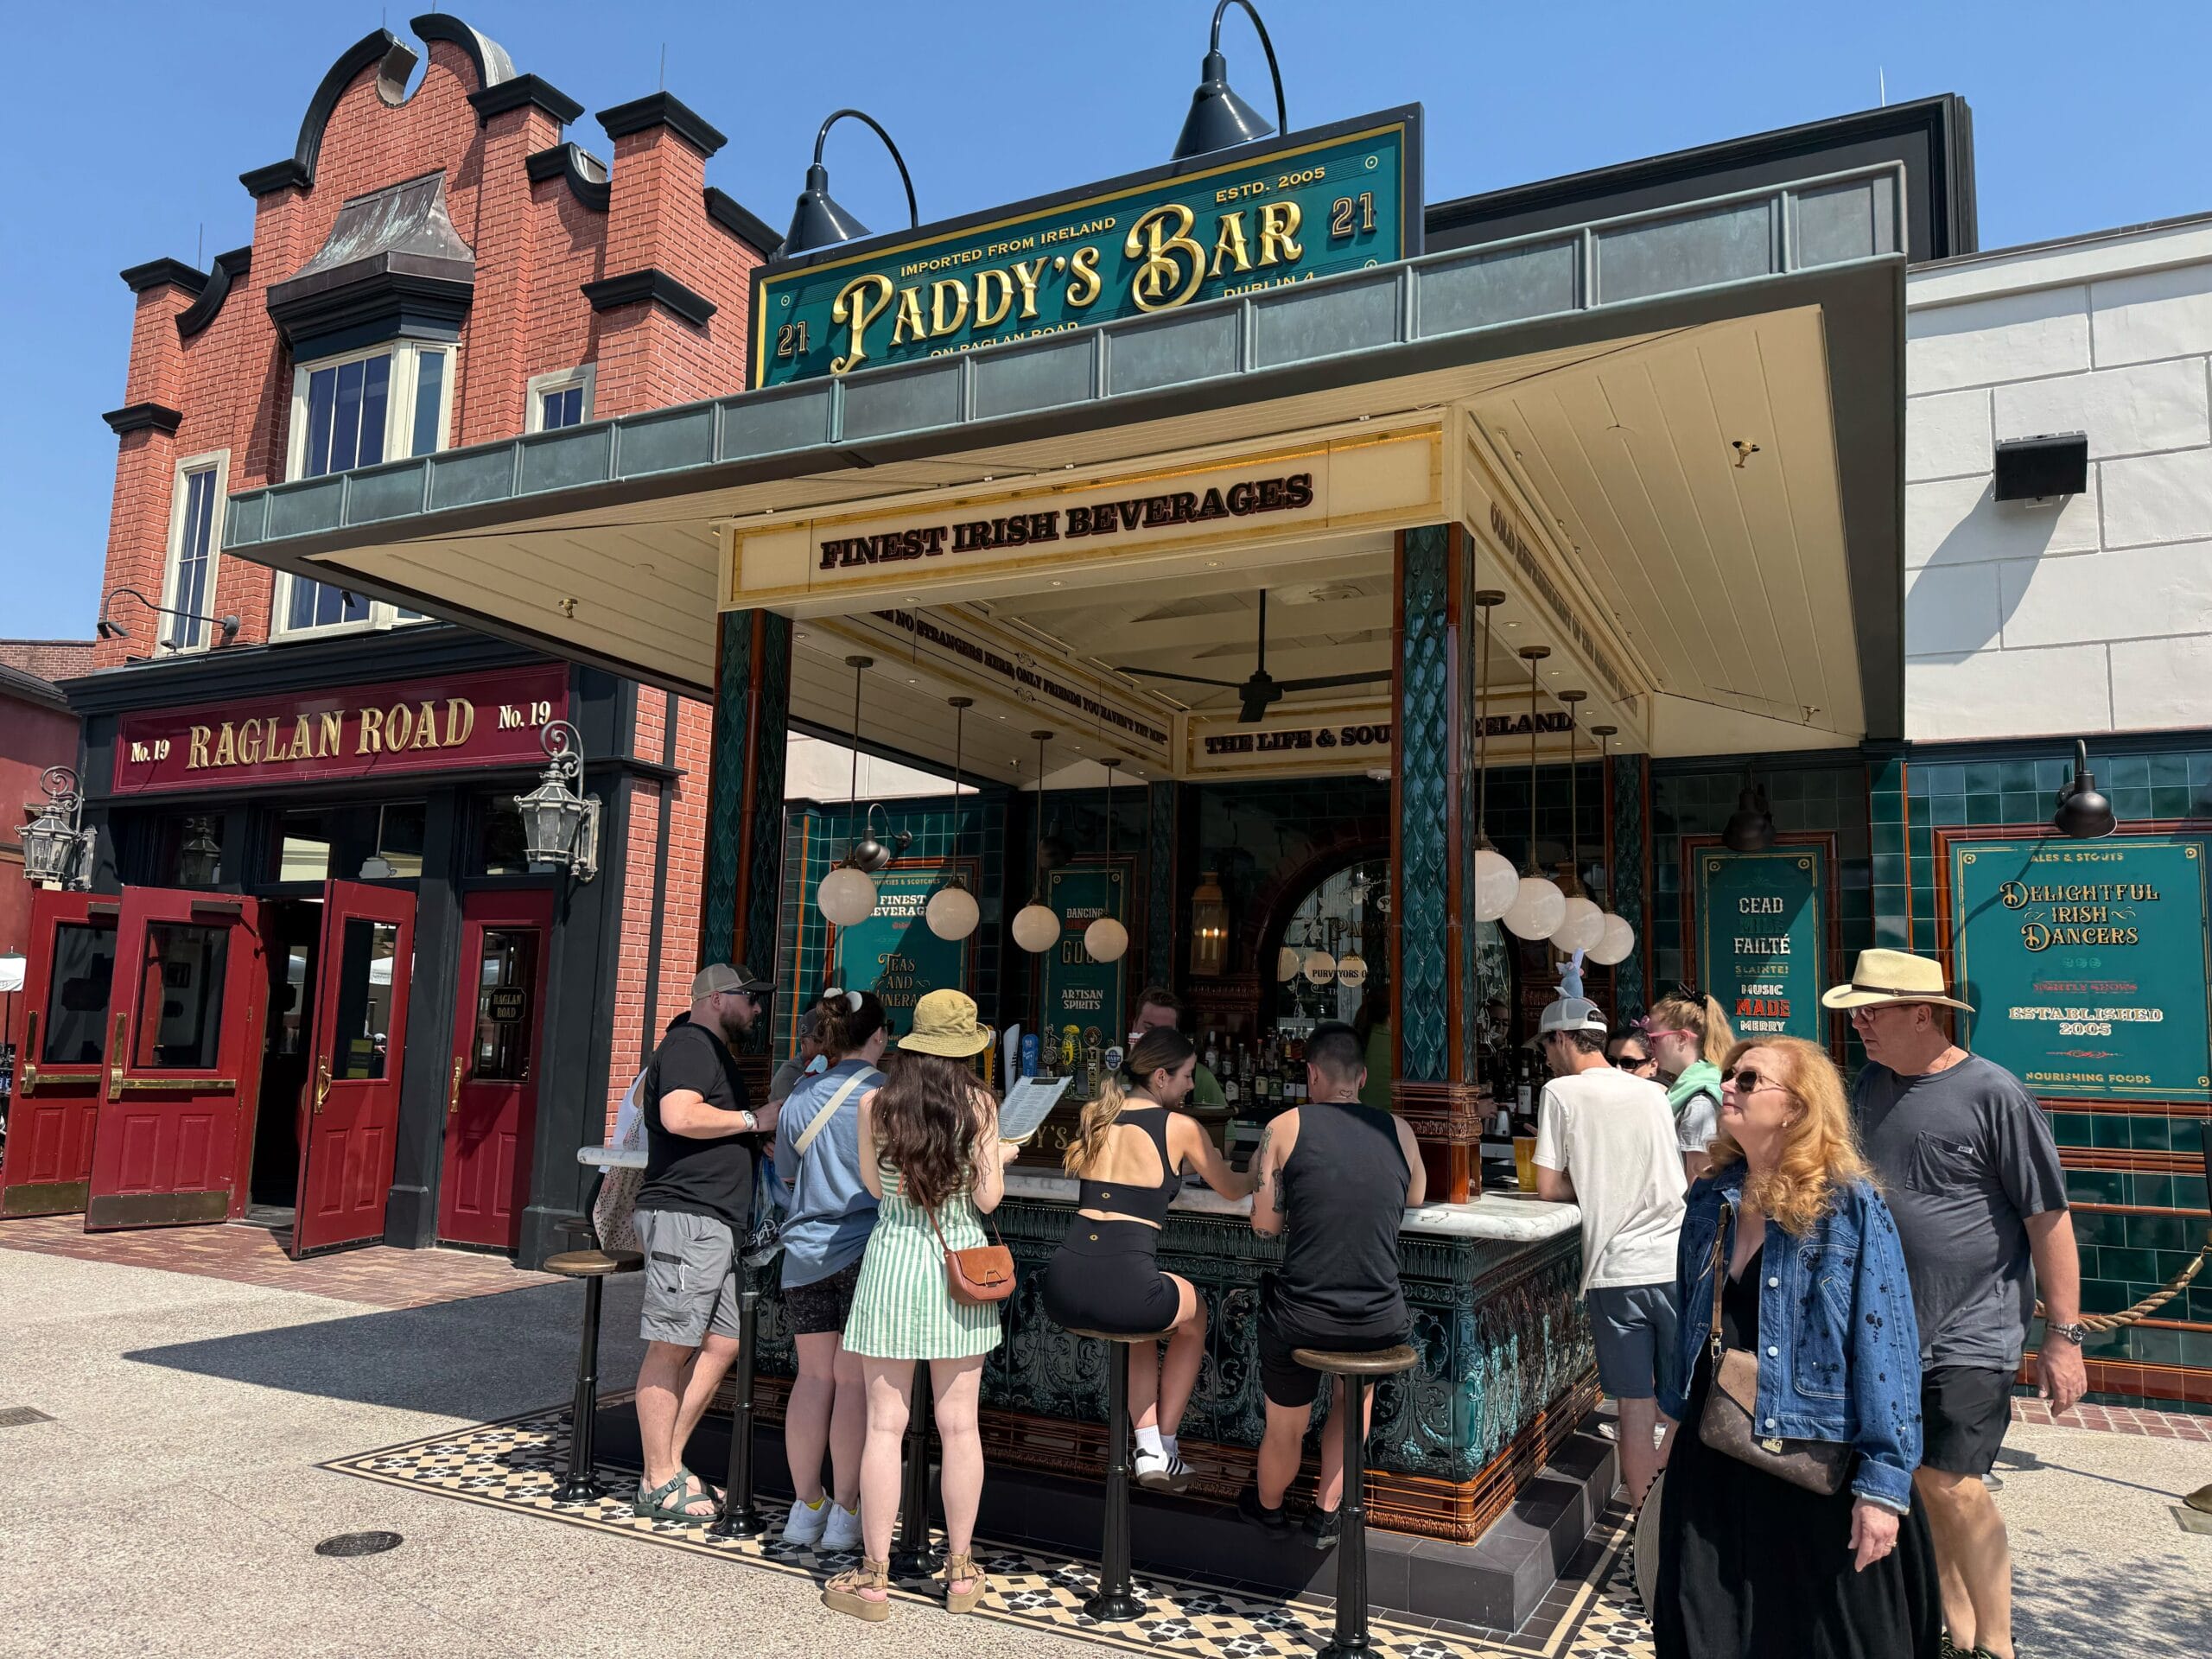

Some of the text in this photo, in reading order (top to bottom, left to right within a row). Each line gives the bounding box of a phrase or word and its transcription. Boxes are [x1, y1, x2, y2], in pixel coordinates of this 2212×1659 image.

[1216, 167, 1325, 203] ESTD. 2005
[1332, 192, 1377, 238] 21
[900, 217, 1116, 277] IMPORTED FROM IRELAND
[830, 201, 1302, 375] PADDY'S BAR
[778, 321, 809, 358] 21
[820, 473, 1313, 569] FINEST IRISH BEVERAGES
[895, 609, 914, 632] NO
[917, 620, 982, 664] STRANGERS
[1016, 666, 1042, 690] ONLY
[1044, 678, 1081, 708] FRIENDS
[1083, 696, 1099, 716] YOU
[498, 701, 551, 728] No. 19
[185, 697, 474, 769] RAGLAN ROAD
[1205, 734, 1253, 754] THE
[1256, 731, 1312, 751] LIFE
[1316, 728, 1337, 747] &
[1341, 725, 1392, 746] SOU
[130, 739, 170, 762] No. 19
[2063, 854, 2074, 862] &
[880, 894, 926, 906] FINEST
[1999, 880, 2160, 909] DELIGHTFUL
[1738, 897, 1783, 913] CEAD
[2052, 906, 2107, 924] IRISH
[1733, 933, 1791, 955] FAILTÉ
[2021, 922, 2139, 951] DANCERS
[1061, 989, 1103, 1000] ARTISAN
[1741, 984, 1783, 995] MUSIC
[493, 995, 522, 1005] RAGLAN
[1063, 1000, 1101, 1009] SPIRITS
[1735, 999, 1790, 1017] MADE
[498, 1007, 516, 1018] ROAD
[2009, 1007, 2164, 1021] ESTABLISHED
[1740, 1020, 1785, 1033] MERRY
[2059, 1022, 2111, 1035] 2005
[2025, 1072, 2152, 1084] NOURISHING FOODS
